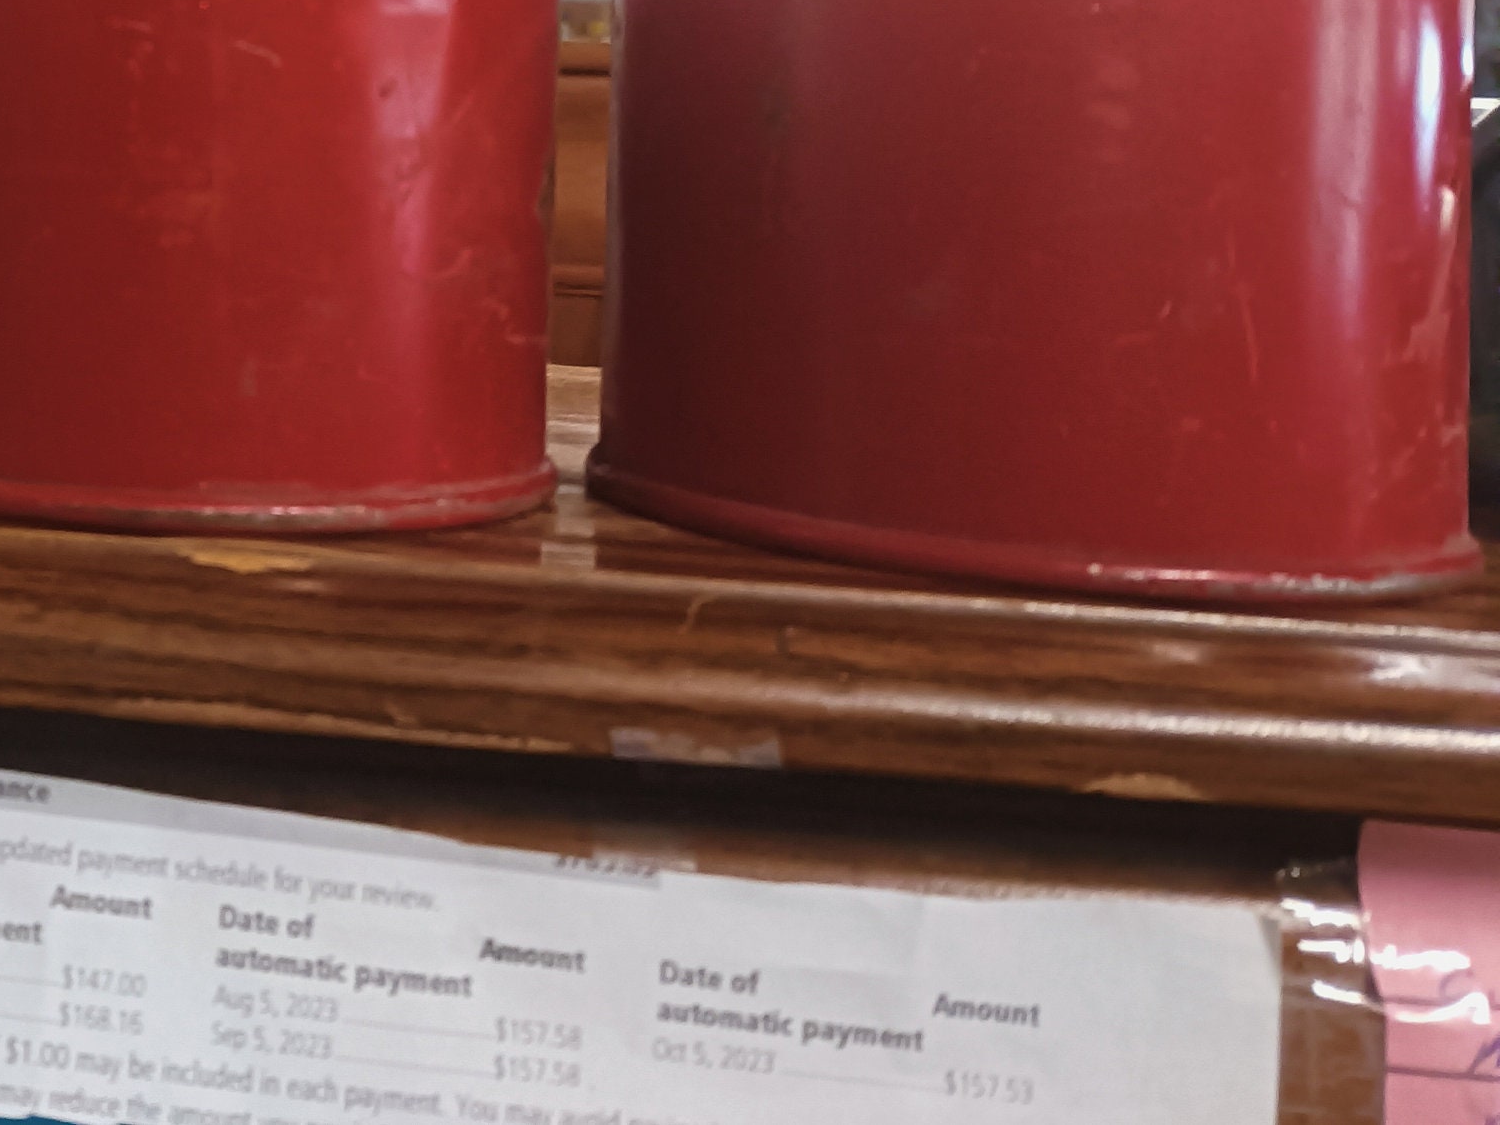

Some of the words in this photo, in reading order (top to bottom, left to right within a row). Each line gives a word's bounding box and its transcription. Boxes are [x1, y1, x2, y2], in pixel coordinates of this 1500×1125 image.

[76, 846, 169, 878] payment
[174, 855, 269, 890] schedule
[308, 878, 357, 905] your
[49, 883, 155, 921] Amount
[219, 902, 280, 936] Date
[286, 912, 315, 941] of
[216, 946, 347, 983] automatic
[354, 961, 474, 998] payment
[479, 938, 587, 973] Amount
[658, 959, 723, 991] Date
[730, 968, 762, 996] of
[657, 1000, 794, 1038] automatic
[800, 1017, 925, 1052] payment
[932, 993, 1042, 1027] Amount
